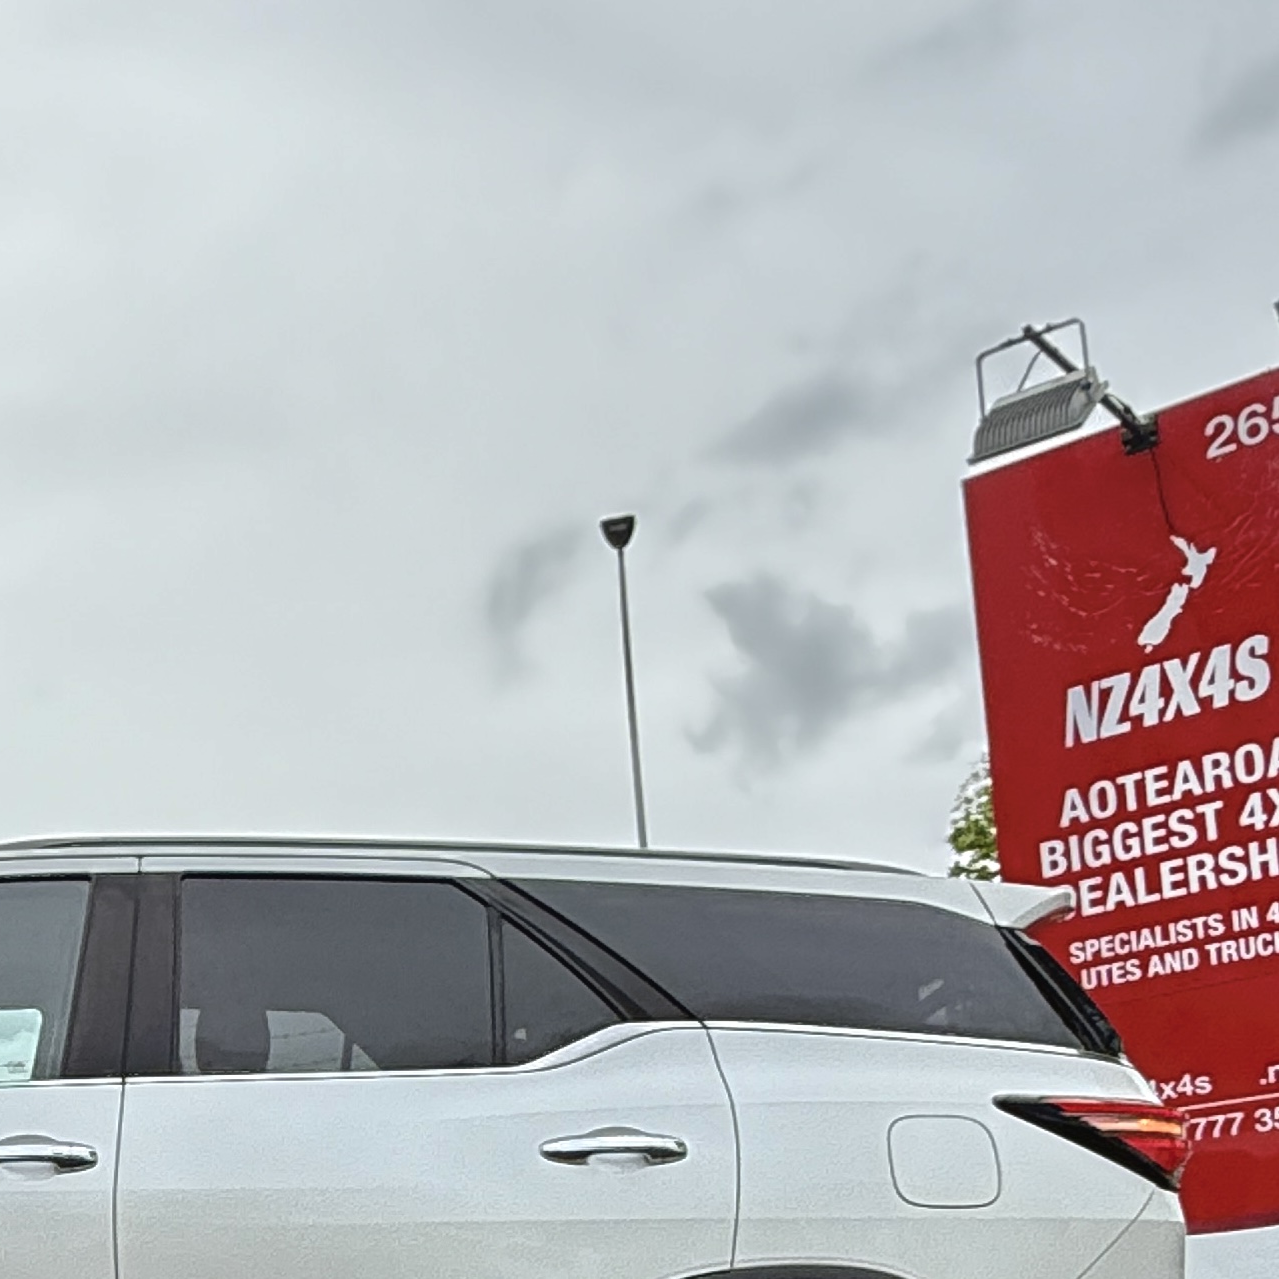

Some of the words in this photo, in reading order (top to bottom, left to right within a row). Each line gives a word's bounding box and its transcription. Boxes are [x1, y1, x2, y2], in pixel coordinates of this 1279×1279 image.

[1064, 634, 1271, 748] NZ4X4S
[1039, 800, 1224, 879] BIGGEST
[1061, 837, 1279, 921] EALERSH
[1069, 913, 1226, 964] SPECIALISTS
[1231, 905, 1259, 932] IN
[1080, 959, 1142, 990] UTES
[1147, 948, 1199, 978] AND
